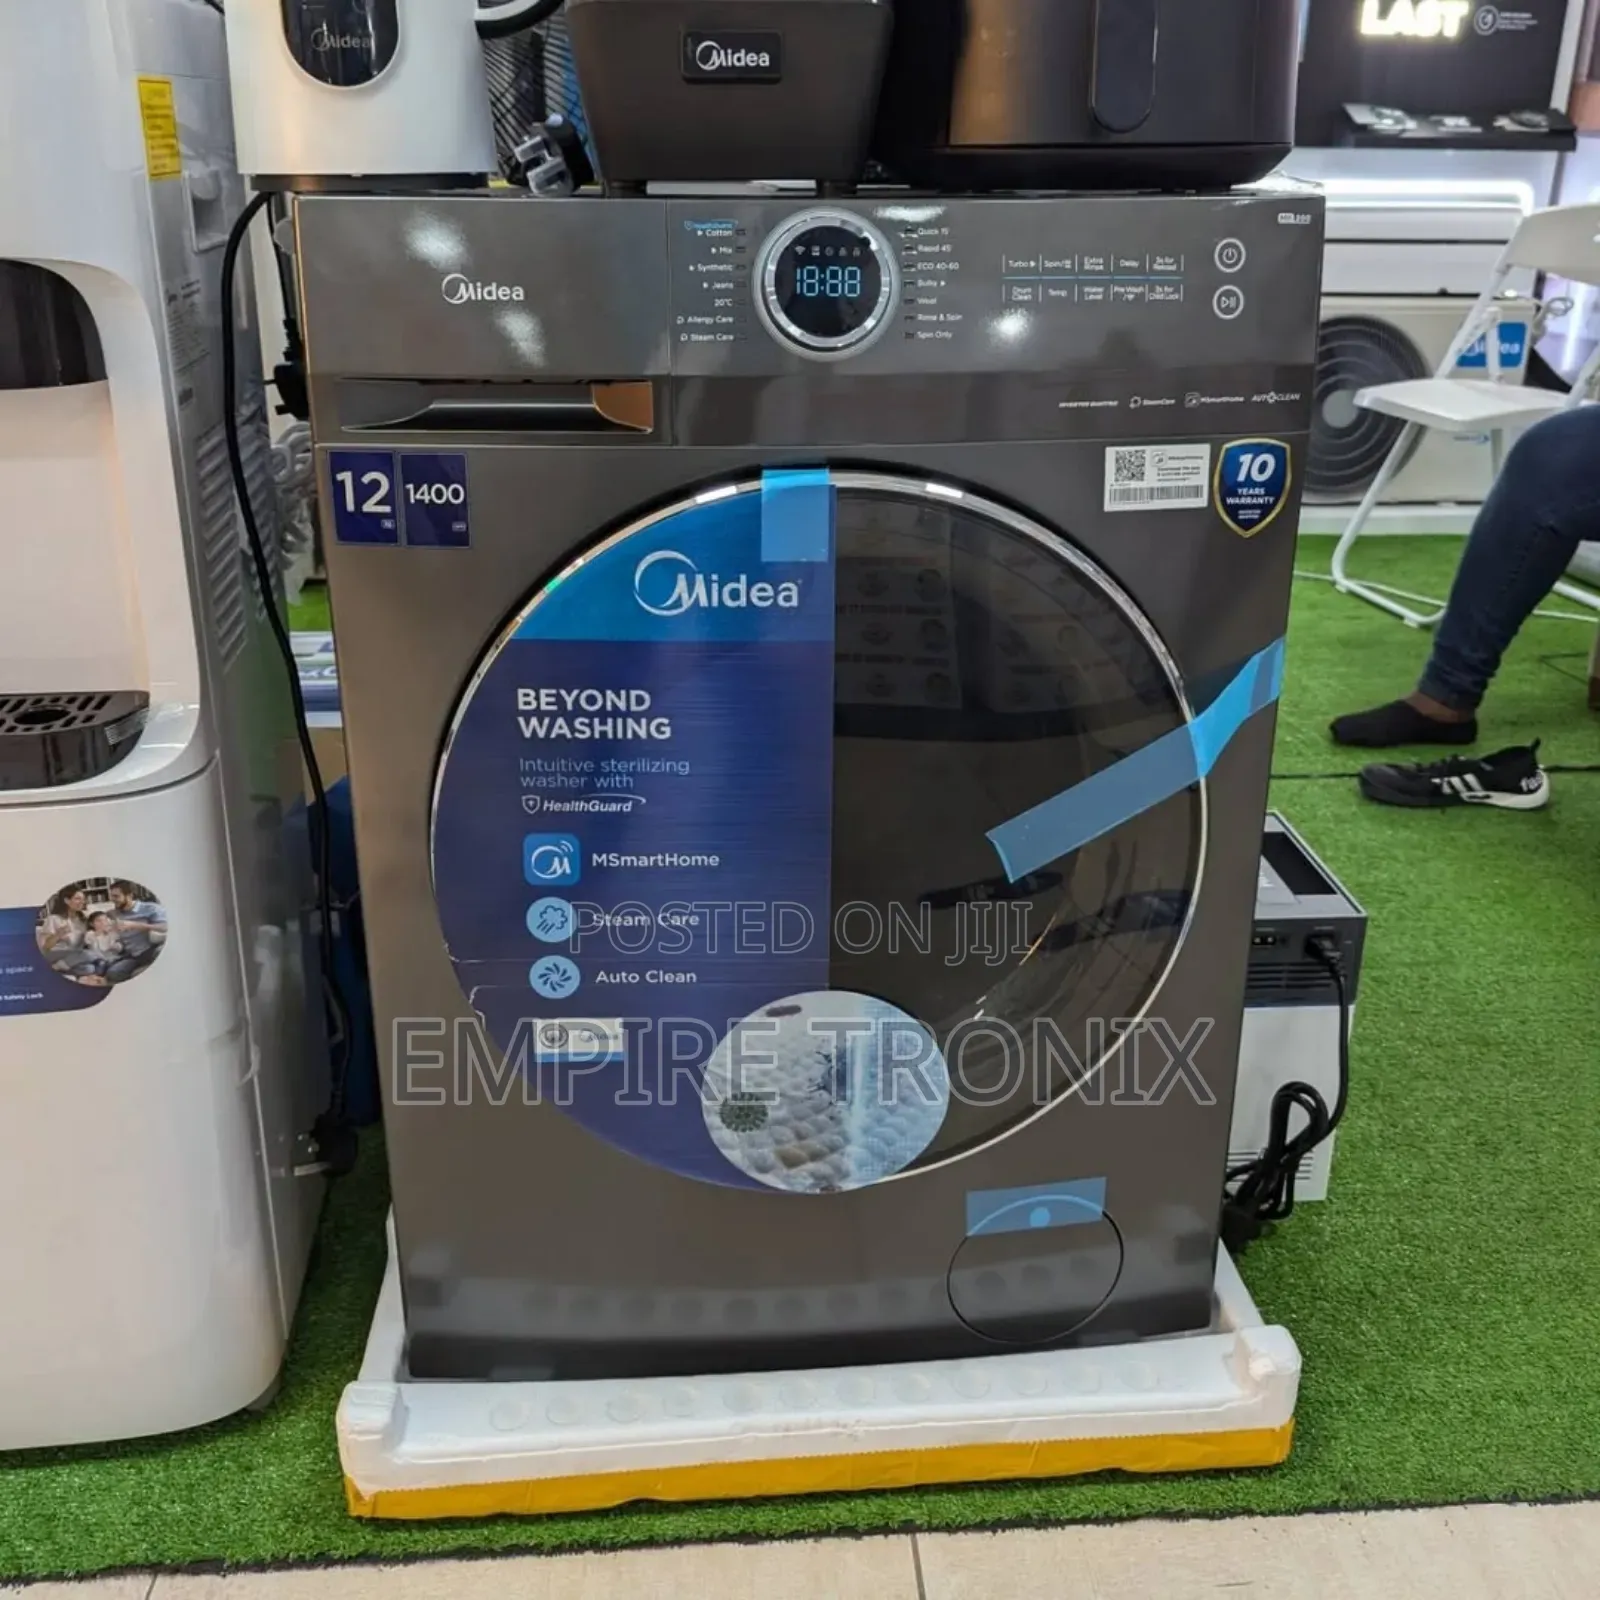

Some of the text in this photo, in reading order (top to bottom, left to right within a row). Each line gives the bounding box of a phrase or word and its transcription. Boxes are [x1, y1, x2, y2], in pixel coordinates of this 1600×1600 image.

[1360, 0, 1469, 37] LAST
[310, 27, 372, 52] Midea
[696, 40, 770, 70] Midea
[442, 273, 525, 304] Midea
[1236, 453, 1276, 482] 10
[335, 470, 392, 513] 12
[405, 483, 465, 504] 1400
[1226, 496, 1275, 505] WARRANTY
[1237, 487, 1266, 495] YEARS
[634, 549, 800, 617] Midea
[516, 688, 652, 712] BEYOND
[517, 717, 672, 740] WASHING
[519, 758, 691, 776] Intuitive sterilizing
[520, 774, 634, 788] washer with
[543, 798, 633, 812] HealthGuard
[591, 853, 720, 867] MSmartHome
[592, 912, 701, 927] Steam Care
[595, 970, 698, 984] Auto Clean
